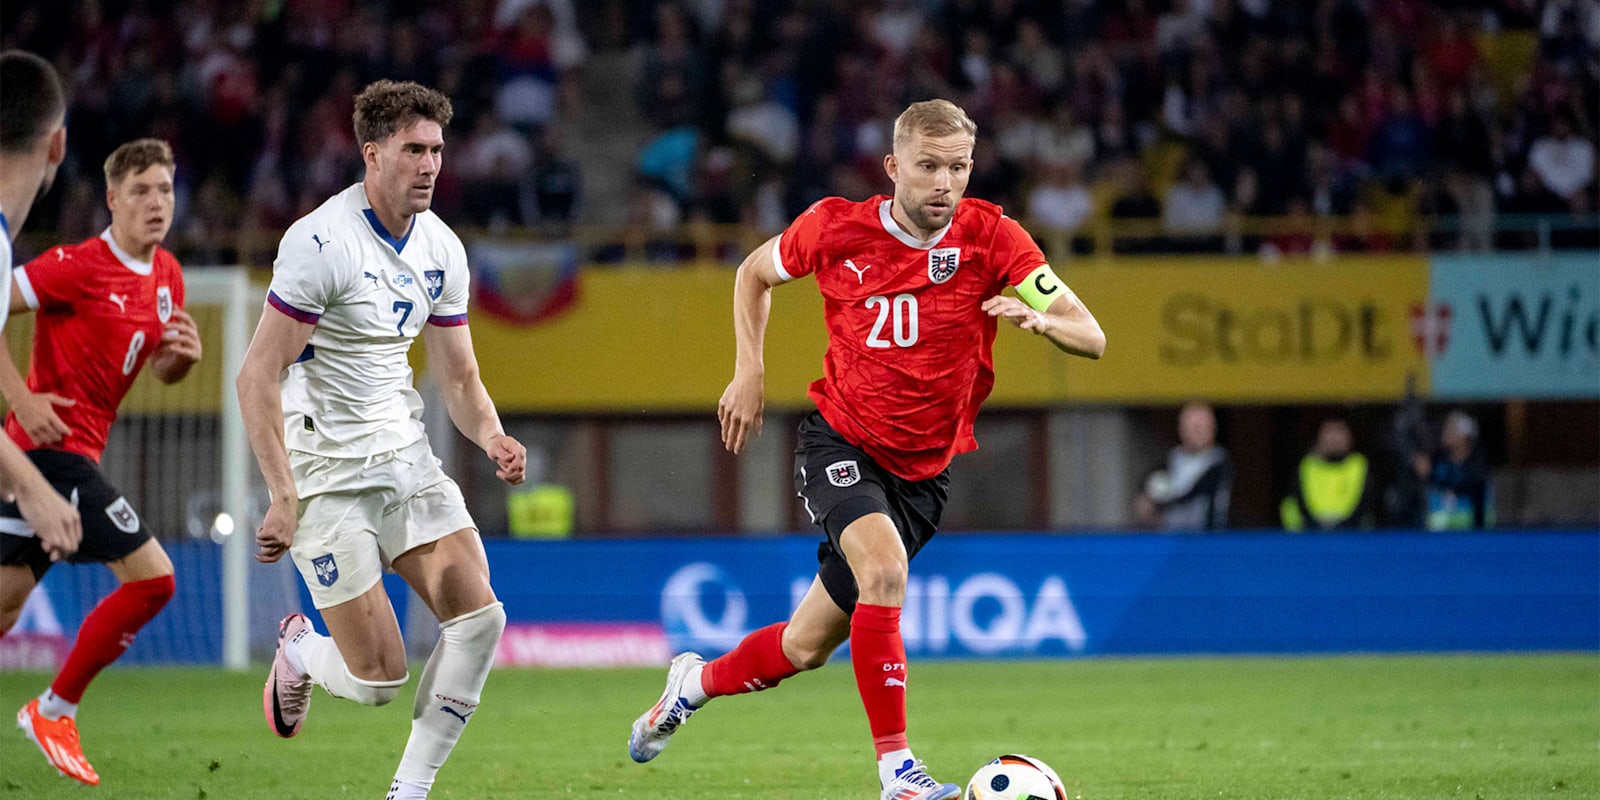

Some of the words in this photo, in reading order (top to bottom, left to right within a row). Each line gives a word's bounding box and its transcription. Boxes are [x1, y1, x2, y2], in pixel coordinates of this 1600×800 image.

[1035, 273, 1058, 295] C
[392, 301, 414, 337] 7
[865, 294, 919, 348] 20
[122, 330, 145, 376] 8
